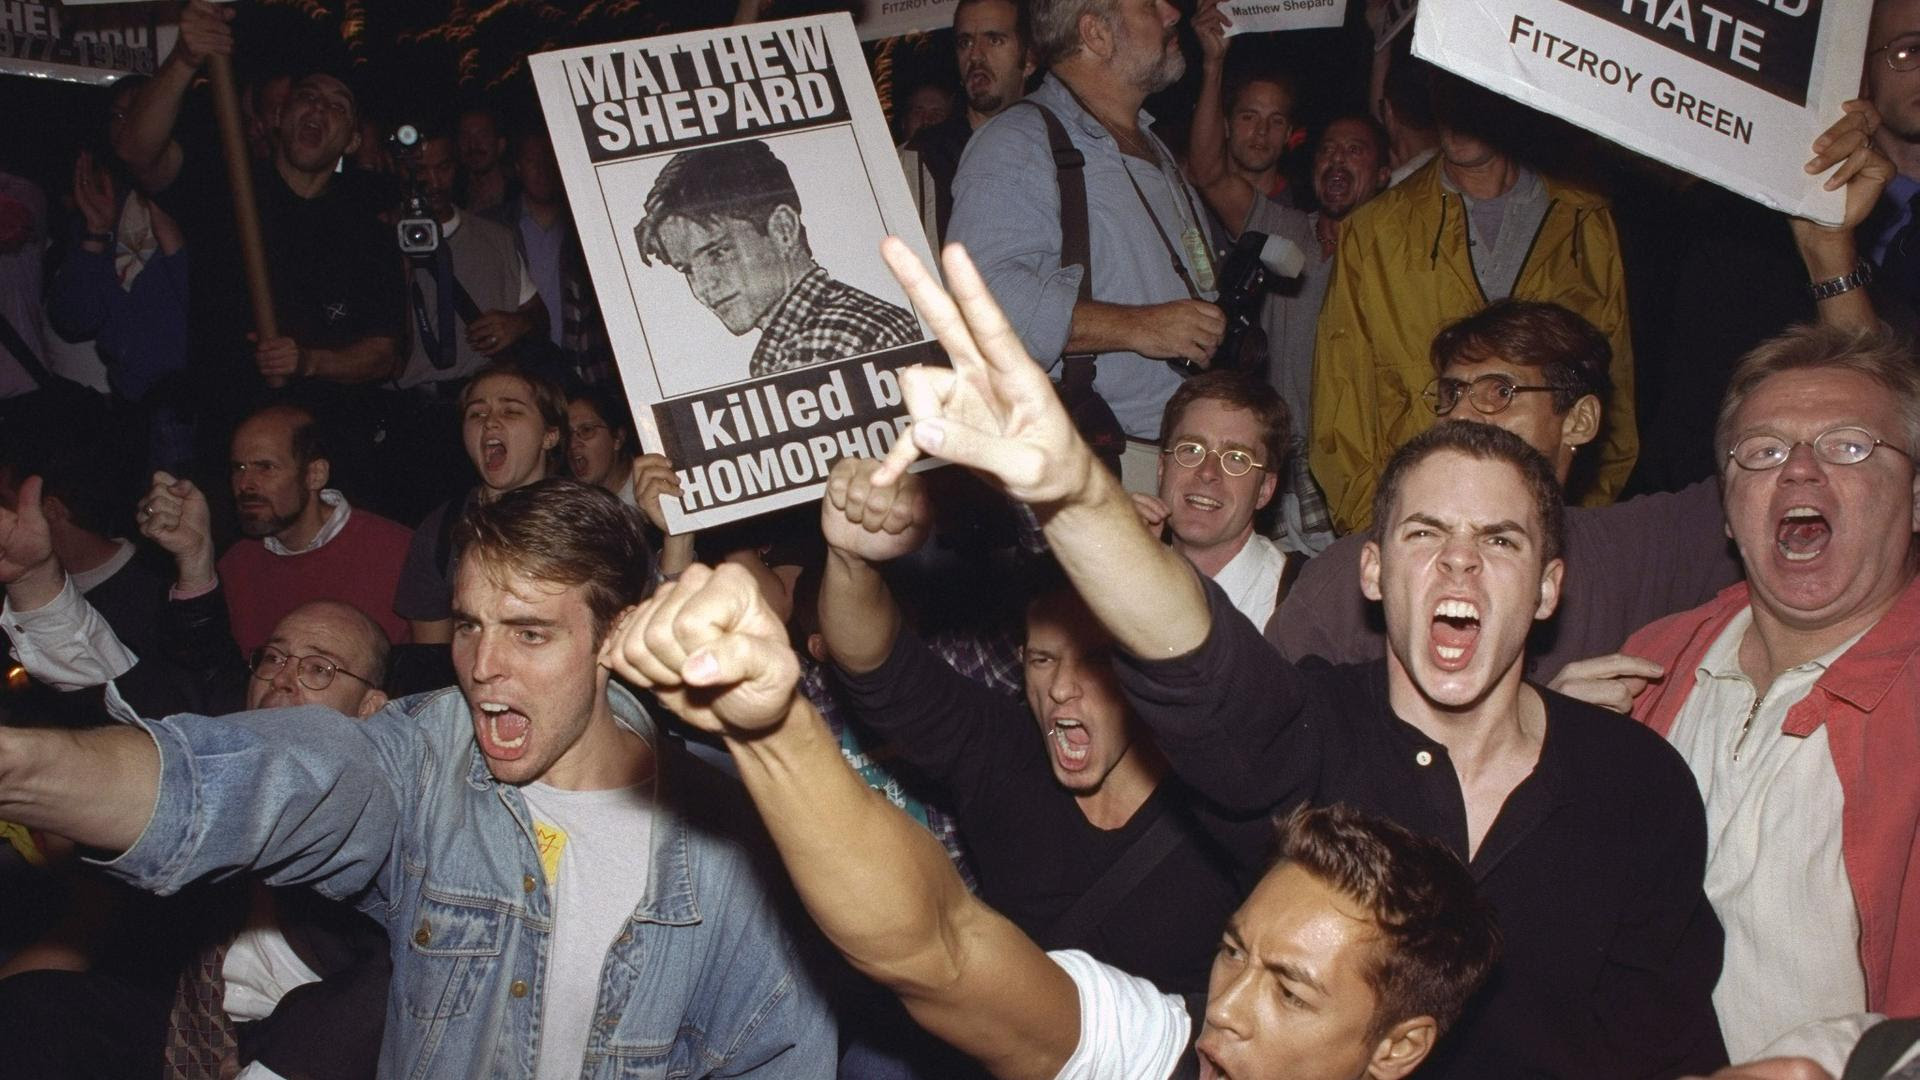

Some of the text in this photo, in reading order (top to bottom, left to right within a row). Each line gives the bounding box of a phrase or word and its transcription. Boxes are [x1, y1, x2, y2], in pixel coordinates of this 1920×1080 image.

[1232, 0, 1334, 16] Matthew Shepard
[564, 24, 829, 106] MATTHEW
[1509, 14, 1753, 144] FITZROY GREEN
[592, 73, 835, 151] SHEPARD
[692, 362, 922, 451] killed b
